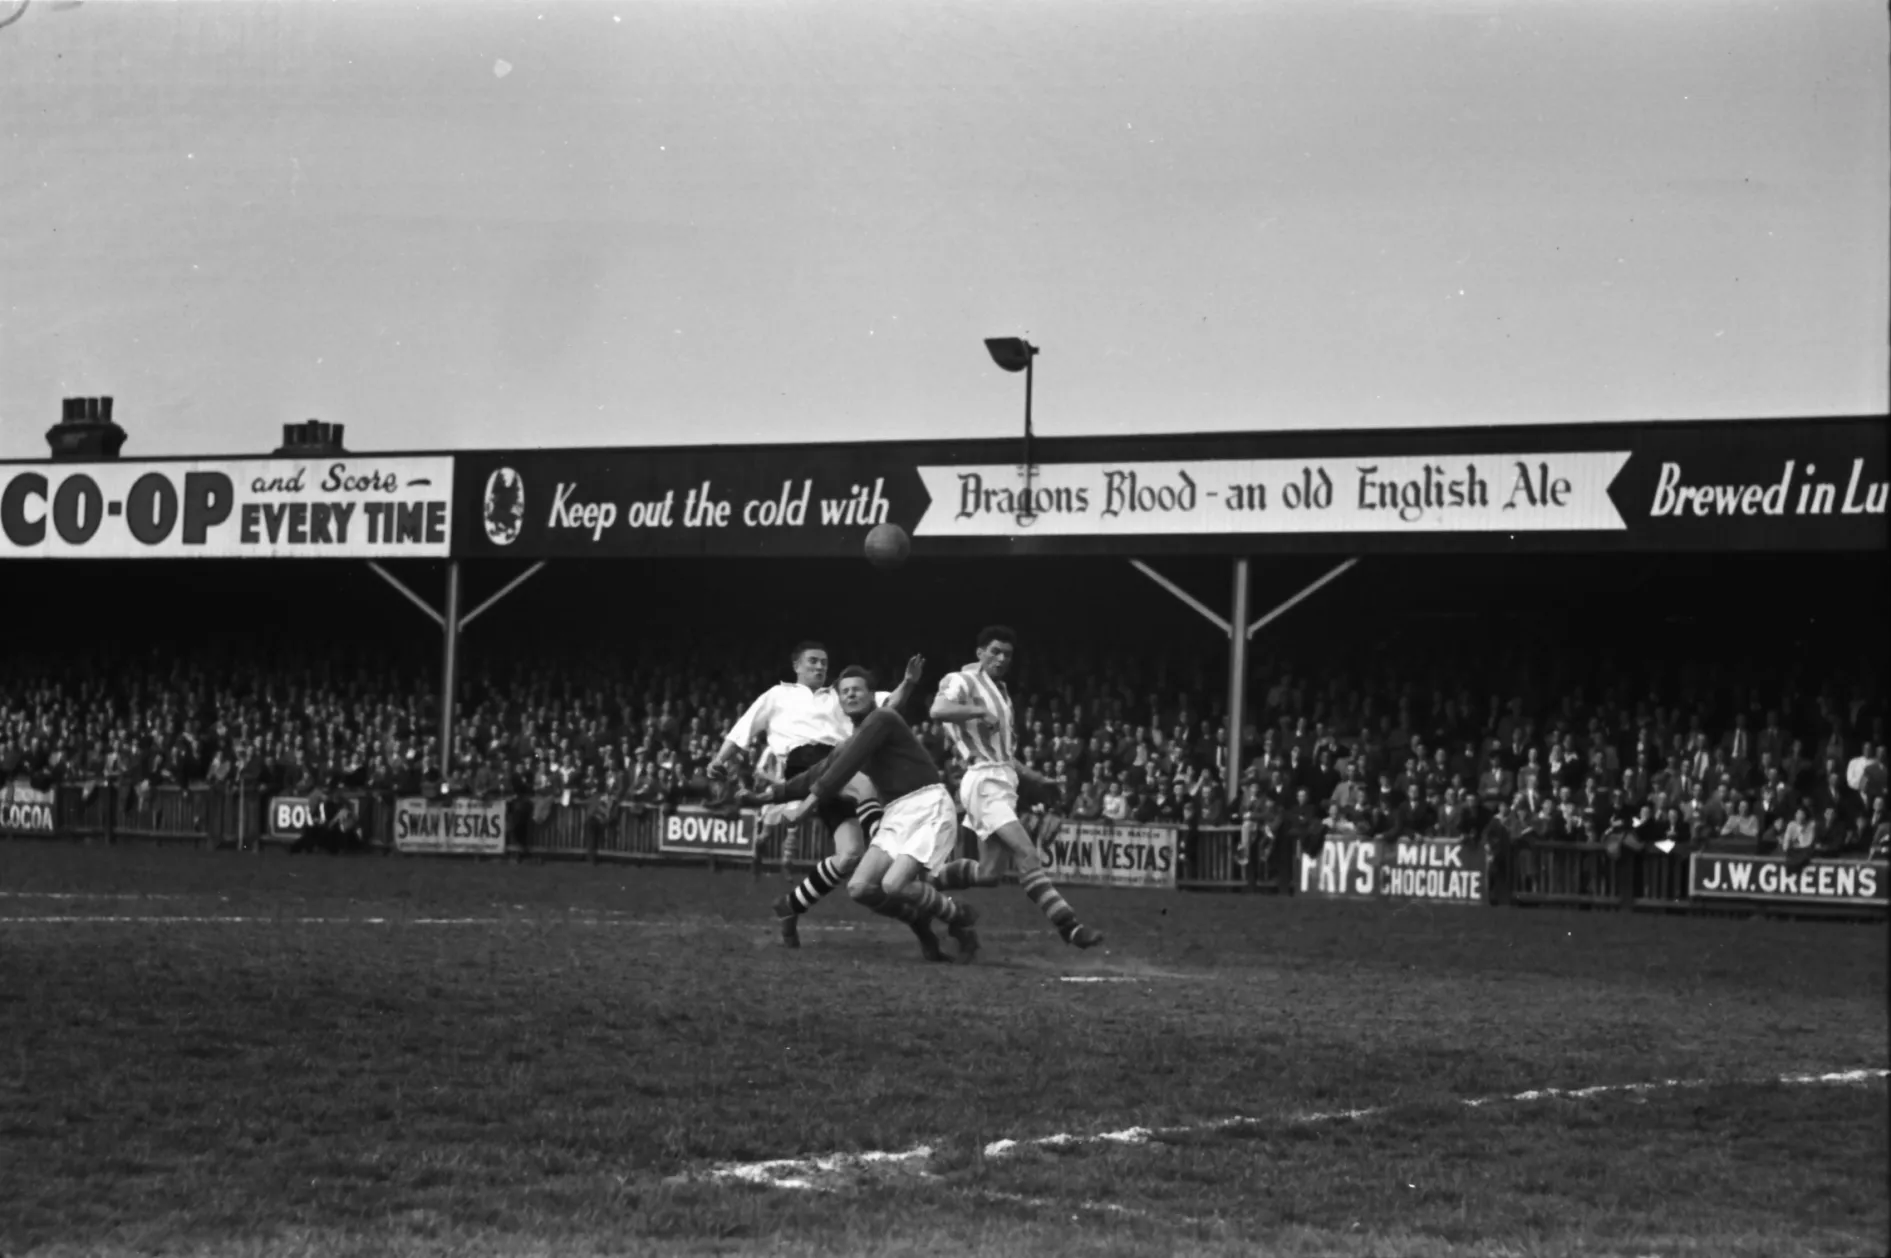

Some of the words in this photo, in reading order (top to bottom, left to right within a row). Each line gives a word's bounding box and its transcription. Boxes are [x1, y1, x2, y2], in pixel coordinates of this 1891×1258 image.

[251, 468, 304, 493] and
[321, 464, 399, 493] Score
[955, 473, 1089, 527] Dragons
[1100, 469, 1197, 519] Blood
[1225, 483, 1267, 511] an
[1283, 465, 1333, 510] old
[1356, 463, 1489, 522] English
[1502, 461, 1572, 511] Ale
[1650, 460, 1795, 517] Brewed
[1796, 463, 1836, 515] in
[1, 472, 235, 547] CO-OP
[240, 502, 356, 544] EVERY
[364, 501, 446, 544] TIME
[548, 483, 617, 541] Keep
[628, 489, 674, 527] out
[683, 480, 731, 527] the
[743, 479, 812, 526] cold
[820, 477, 890, 526] with
[0, 804, 53, 831] COCOA
[398, 809, 440, 839] SWAN
[443, 812, 502, 839] VESTAS
[667, 815, 749, 845] BOVRIL
[1041, 838, 1093, 868] SWAN
[1099, 838, 1171, 872] VESTAS
[1397, 843, 1462, 868] MILK
[1379, 865, 1482, 899] CHOCOLATE
